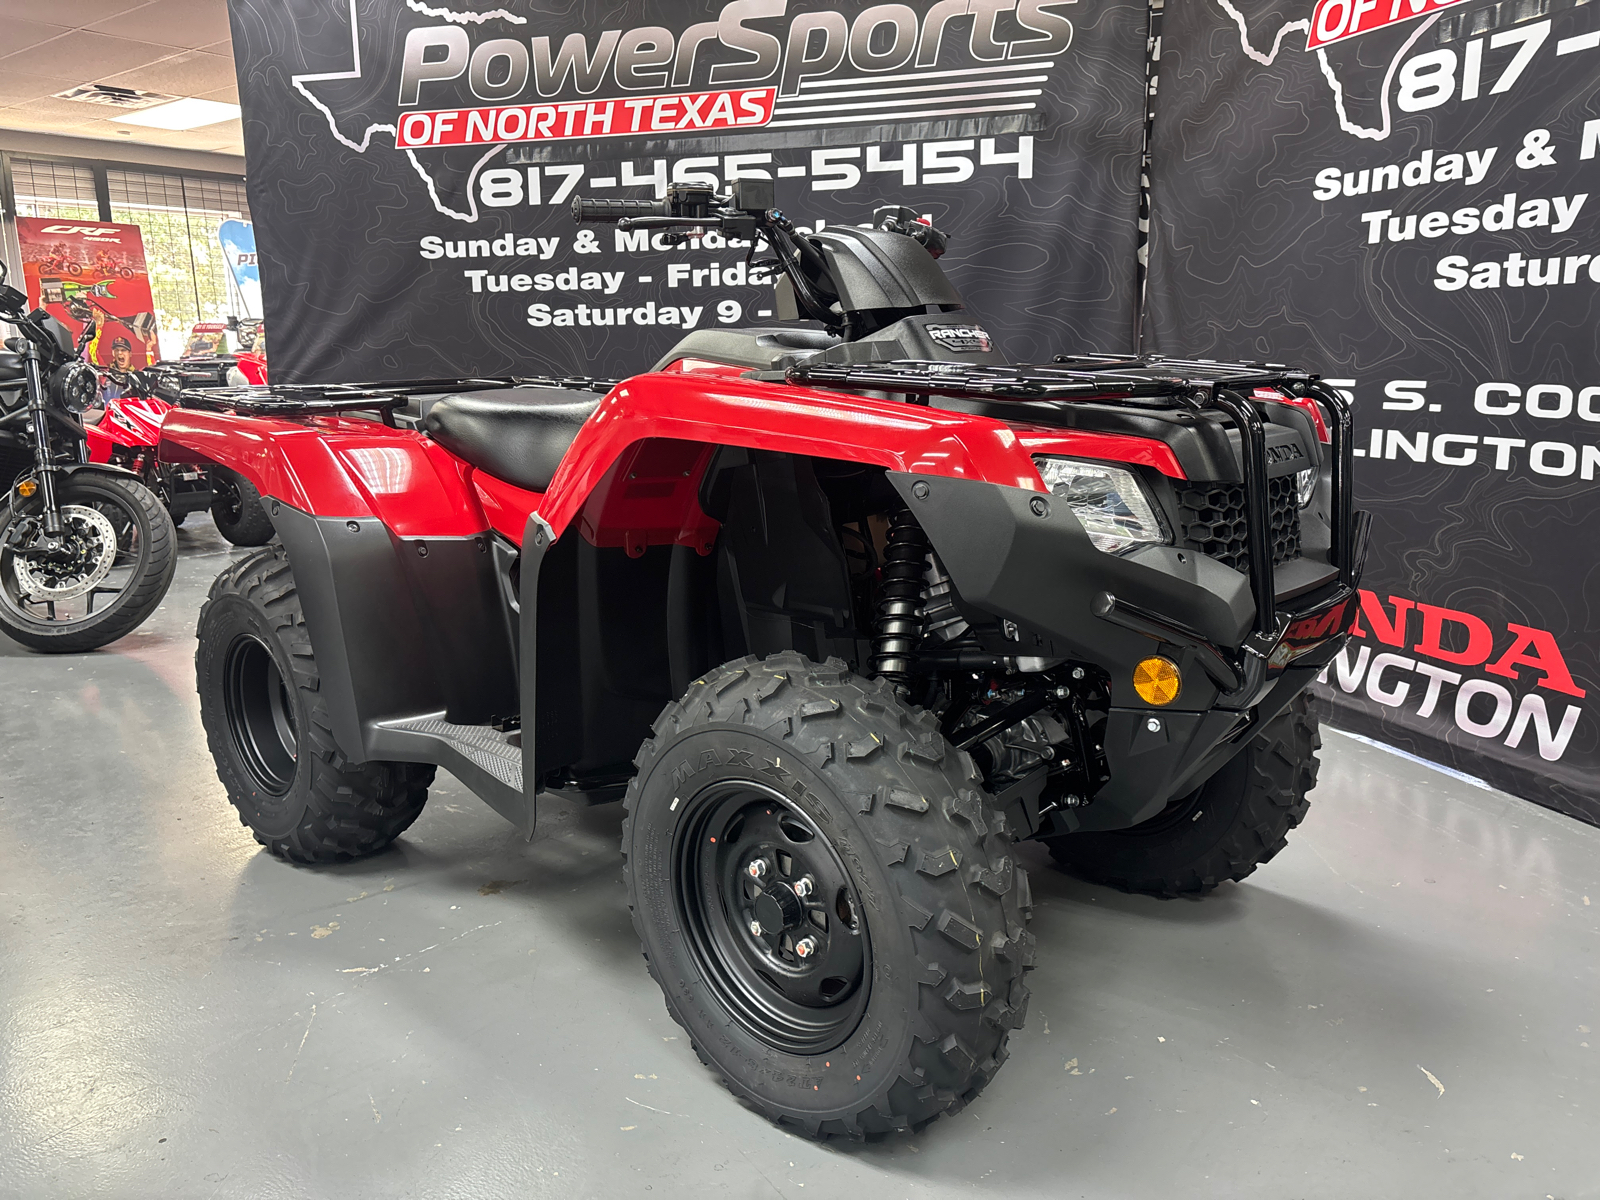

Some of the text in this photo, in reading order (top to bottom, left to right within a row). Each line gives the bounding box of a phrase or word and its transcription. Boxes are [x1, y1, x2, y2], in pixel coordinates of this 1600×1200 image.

[398, 0, 1077, 107] PowerSports
[402, 90, 768, 146] OF NORTH TEXAS
[479, 136, 1034, 208] 817-465-5454
[1312, 146, 1499, 202] Sunday
[1515, 128, 1558, 170] &
[41, 225, 122, 236] CRF
[1360, 192, 1589, 245] Tuesday
[237, 253, 258, 266] PI
[419, 232, 561, 260] Sunday
[572, 229, 602, 254] &
[463, 266, 625, 294] Tuesday
[526, 300, 703, 330] Saturday
[716, 301, 742, 323] 9
[929, 328, 991, 340] RANCHER
[1383, 379, 1442, 412] S.
[670, 748, 833, 824] MAXXIS
